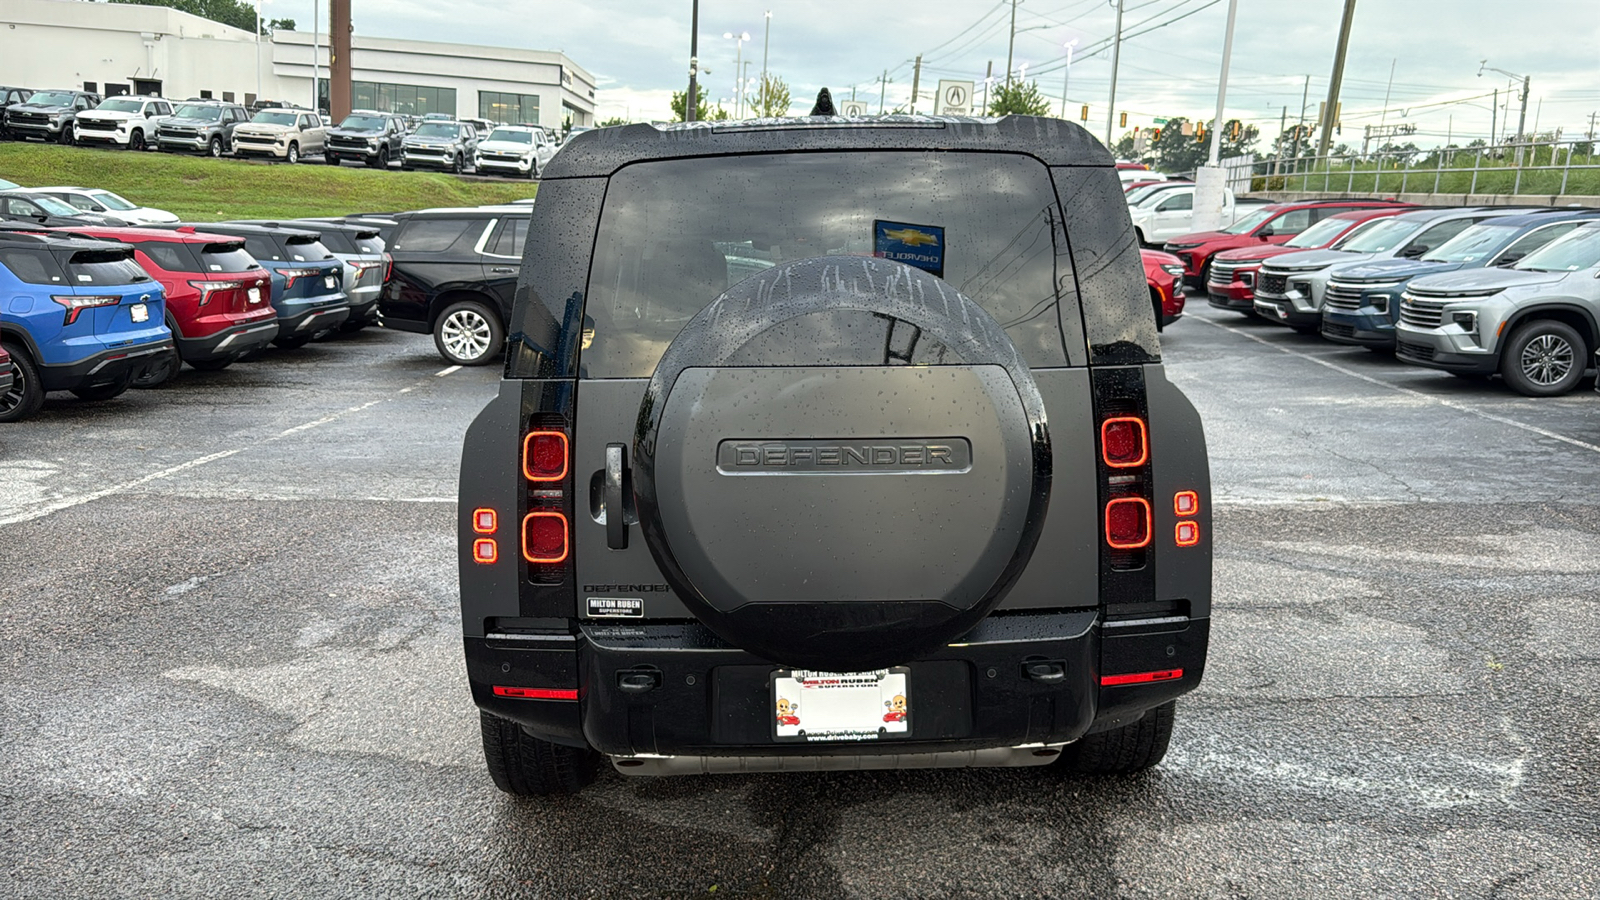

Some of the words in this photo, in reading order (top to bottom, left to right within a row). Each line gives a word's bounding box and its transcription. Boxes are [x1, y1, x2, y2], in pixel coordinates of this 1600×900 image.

[736, 446, 952, 466] DEFENDER
[590, 600, 616, 608] MILTON
[617, 600, 640, 608] RUBEN
